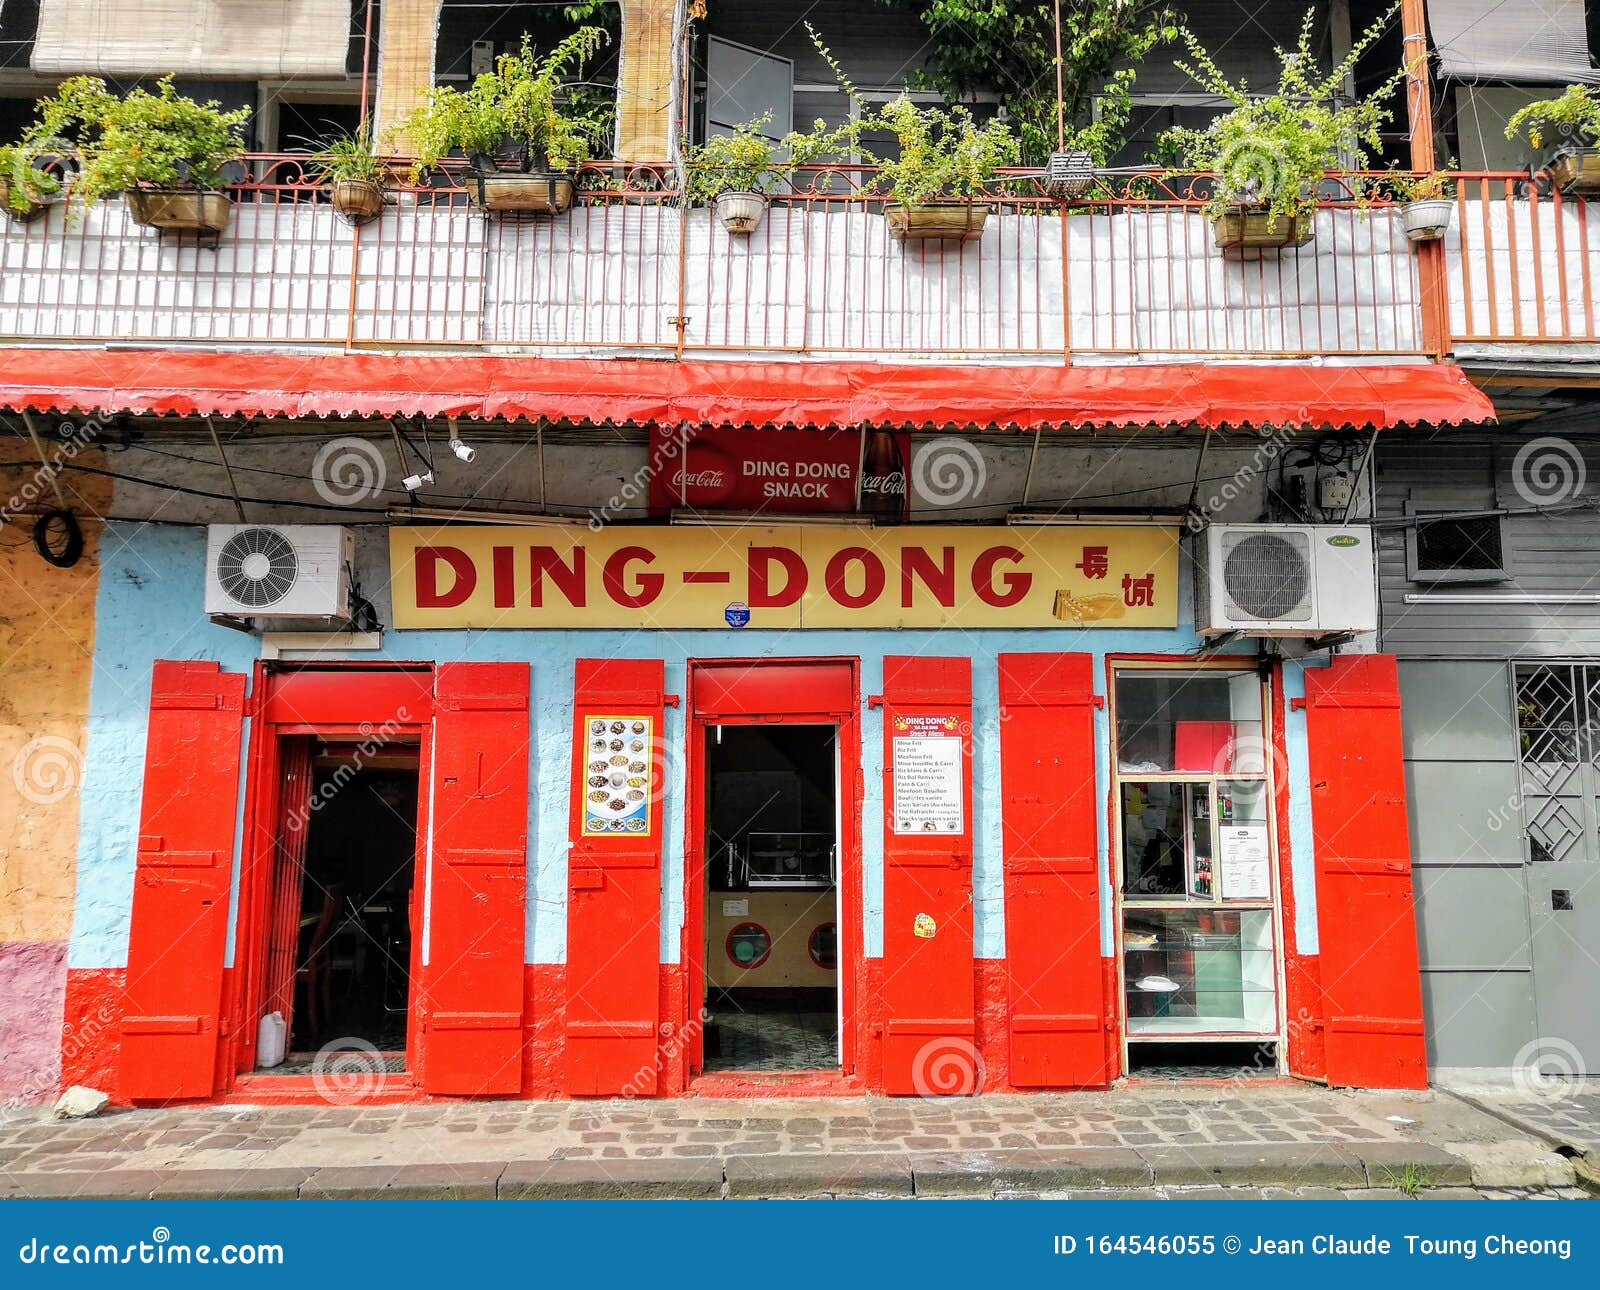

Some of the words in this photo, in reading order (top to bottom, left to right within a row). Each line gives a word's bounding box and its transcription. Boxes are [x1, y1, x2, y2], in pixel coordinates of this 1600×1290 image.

[743, 460, 790, 478] DING
[795, 461, 850, 479] DONG
[763, 482, 829, 499] SNACK
[905, 717, 925, 725] DING
[925, 717, 948, 725] DONG
